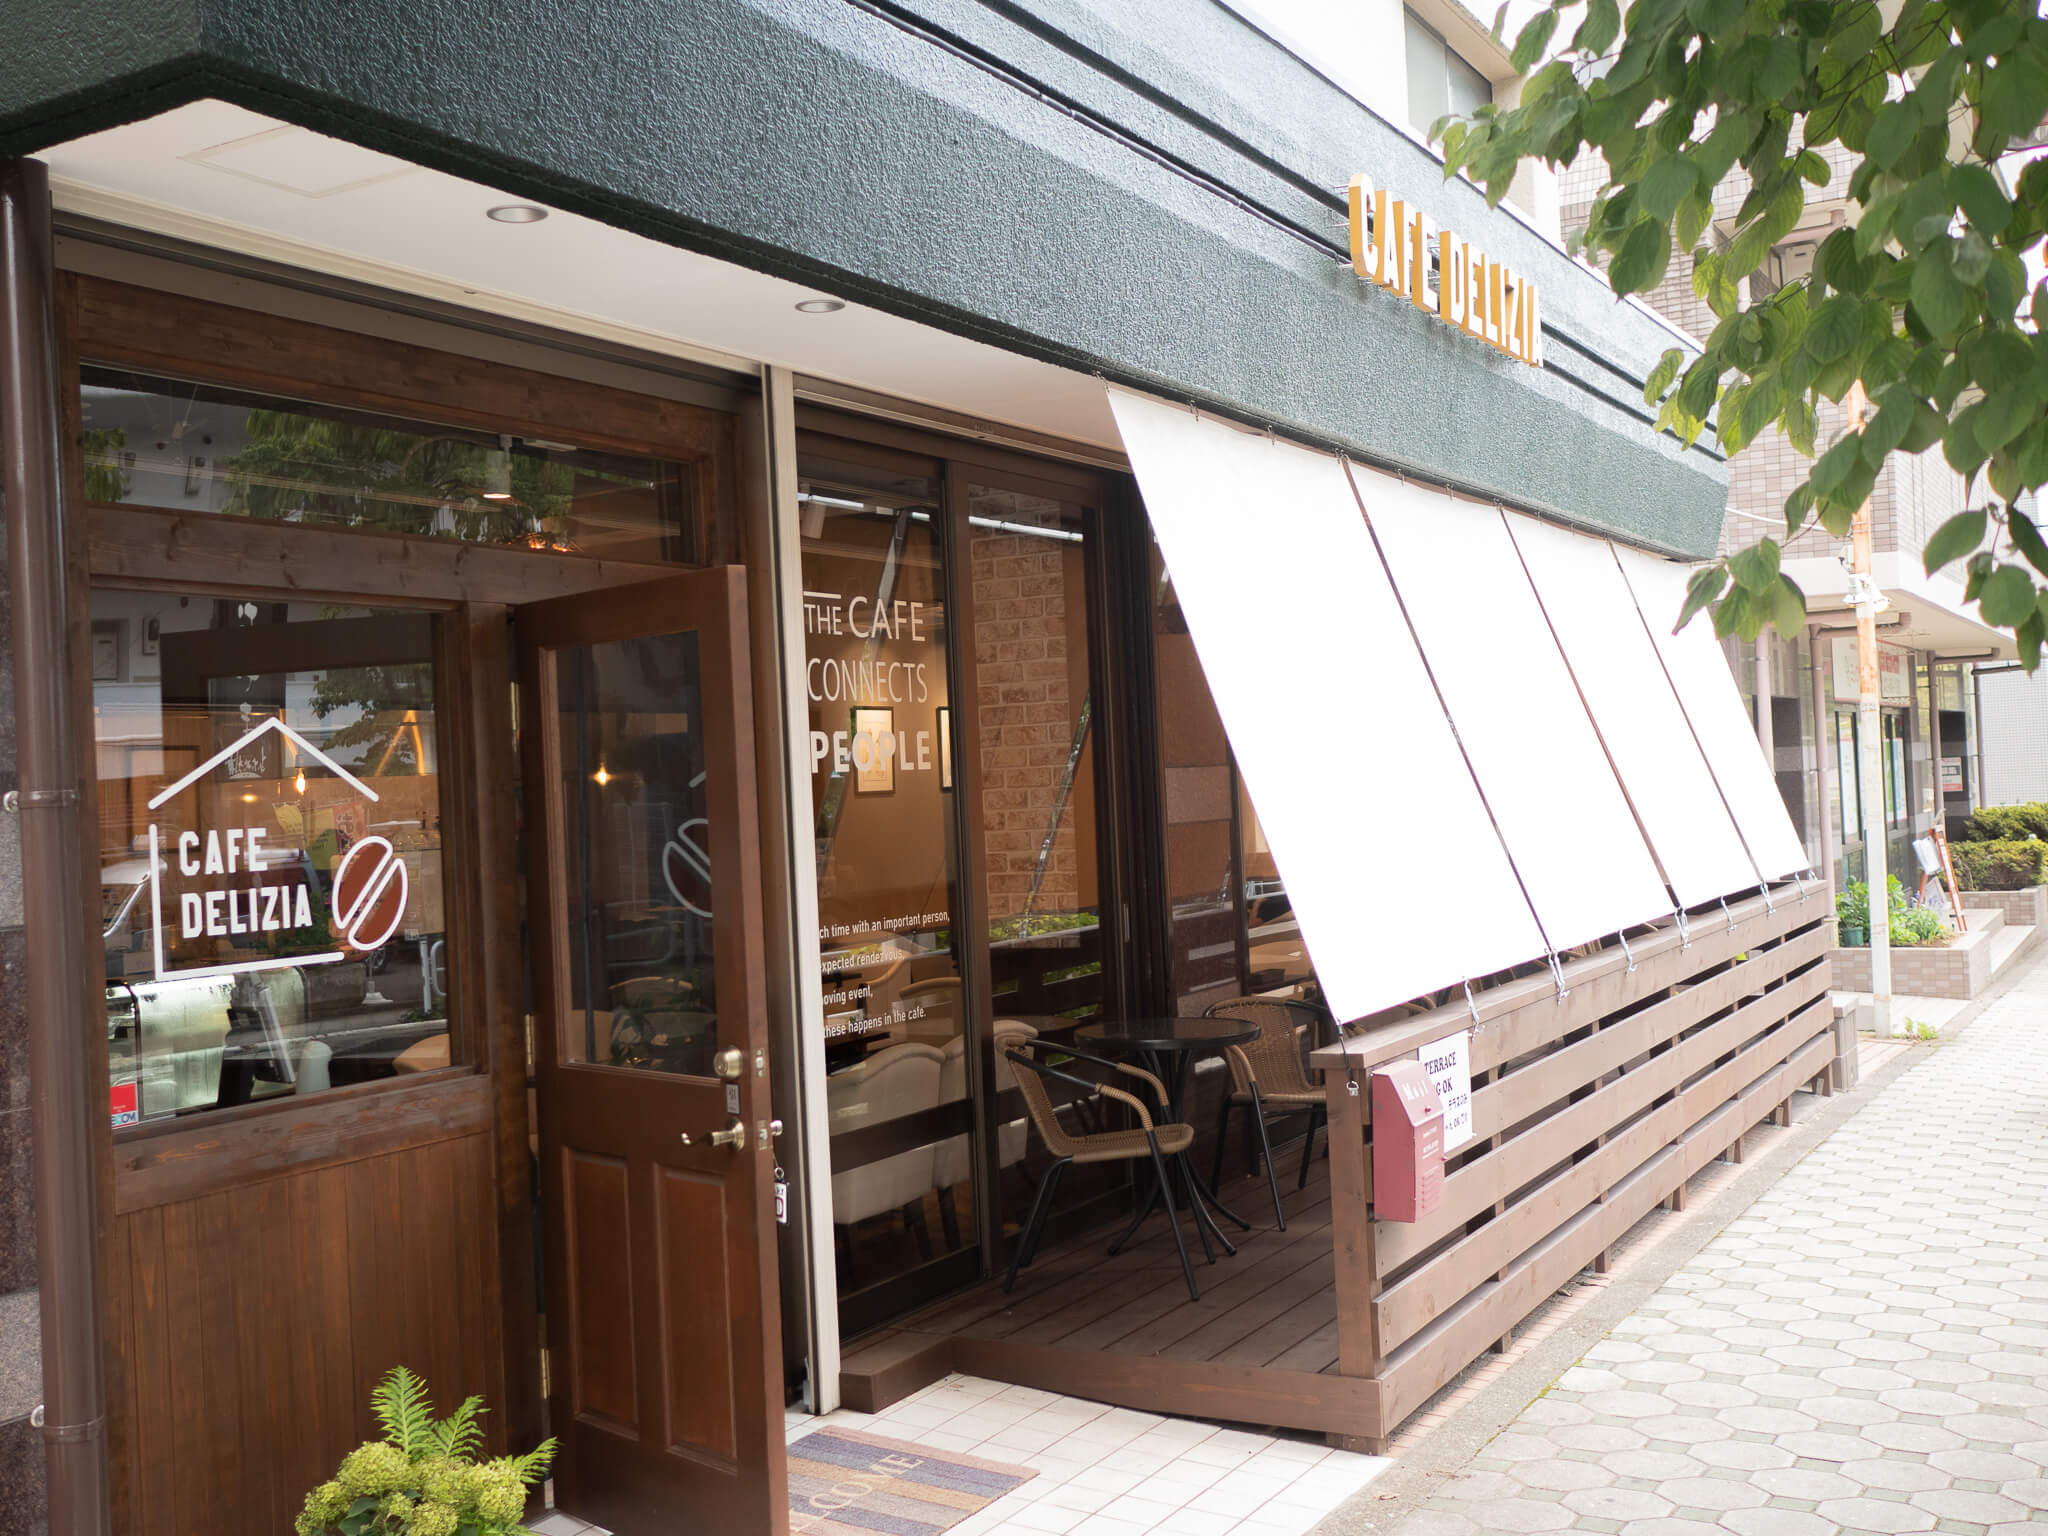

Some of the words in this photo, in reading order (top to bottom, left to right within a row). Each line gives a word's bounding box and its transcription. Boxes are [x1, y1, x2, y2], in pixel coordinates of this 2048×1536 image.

[1348, 173, 1438, 313] CAFE
[803, 603, 843, 636] THE
[849, 596, 926, 642] CAFE
[807, 657, 928, 703] CONNECTS
[810, 730, 932, 774] PEOPLE
[178, 827, 268, 877] CAFE
[181, 884, 313, 939] DELIZIA
[831, 923, 851, 937] time
[852, 919, 870, 934] with
[871, 920, 882, 931] an
[884, 913, 921, 930] important
[820, 953, 855, 975] xpected
[823, 988, 847, 1005] oving
[848, 1016, 883, 1035] happens
[884, 1012, 892, 1025] in
[894, 1008, 906, 1023] the
[1424, 1051, 1457, 1075] TERRACE
[1442, 1077, 1453, 1094] OK
